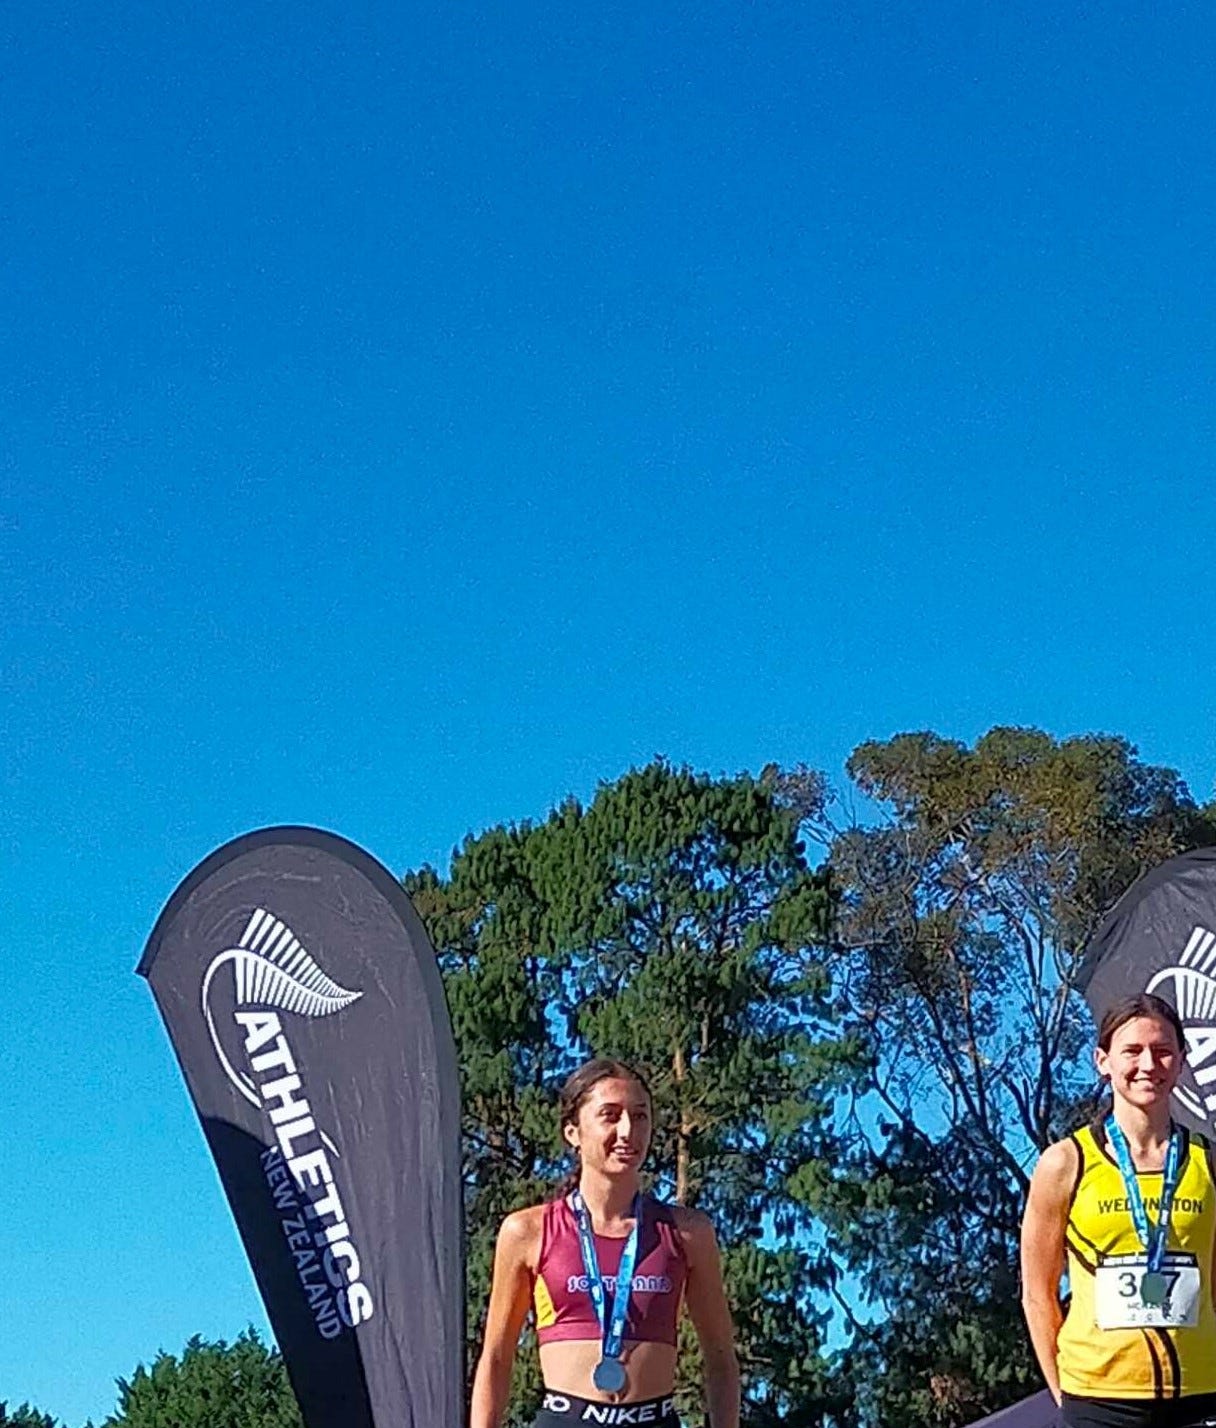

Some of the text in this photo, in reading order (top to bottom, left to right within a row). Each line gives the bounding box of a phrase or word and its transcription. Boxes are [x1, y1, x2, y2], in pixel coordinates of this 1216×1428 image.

[234, 1012, 374, 1327] ATHLETICS
[260, 1146, 342, 1340] NEW ZEALAND
[1118, 1272, 1181, 1298] 37
[582, 1402, 658, 1424] NIKE
